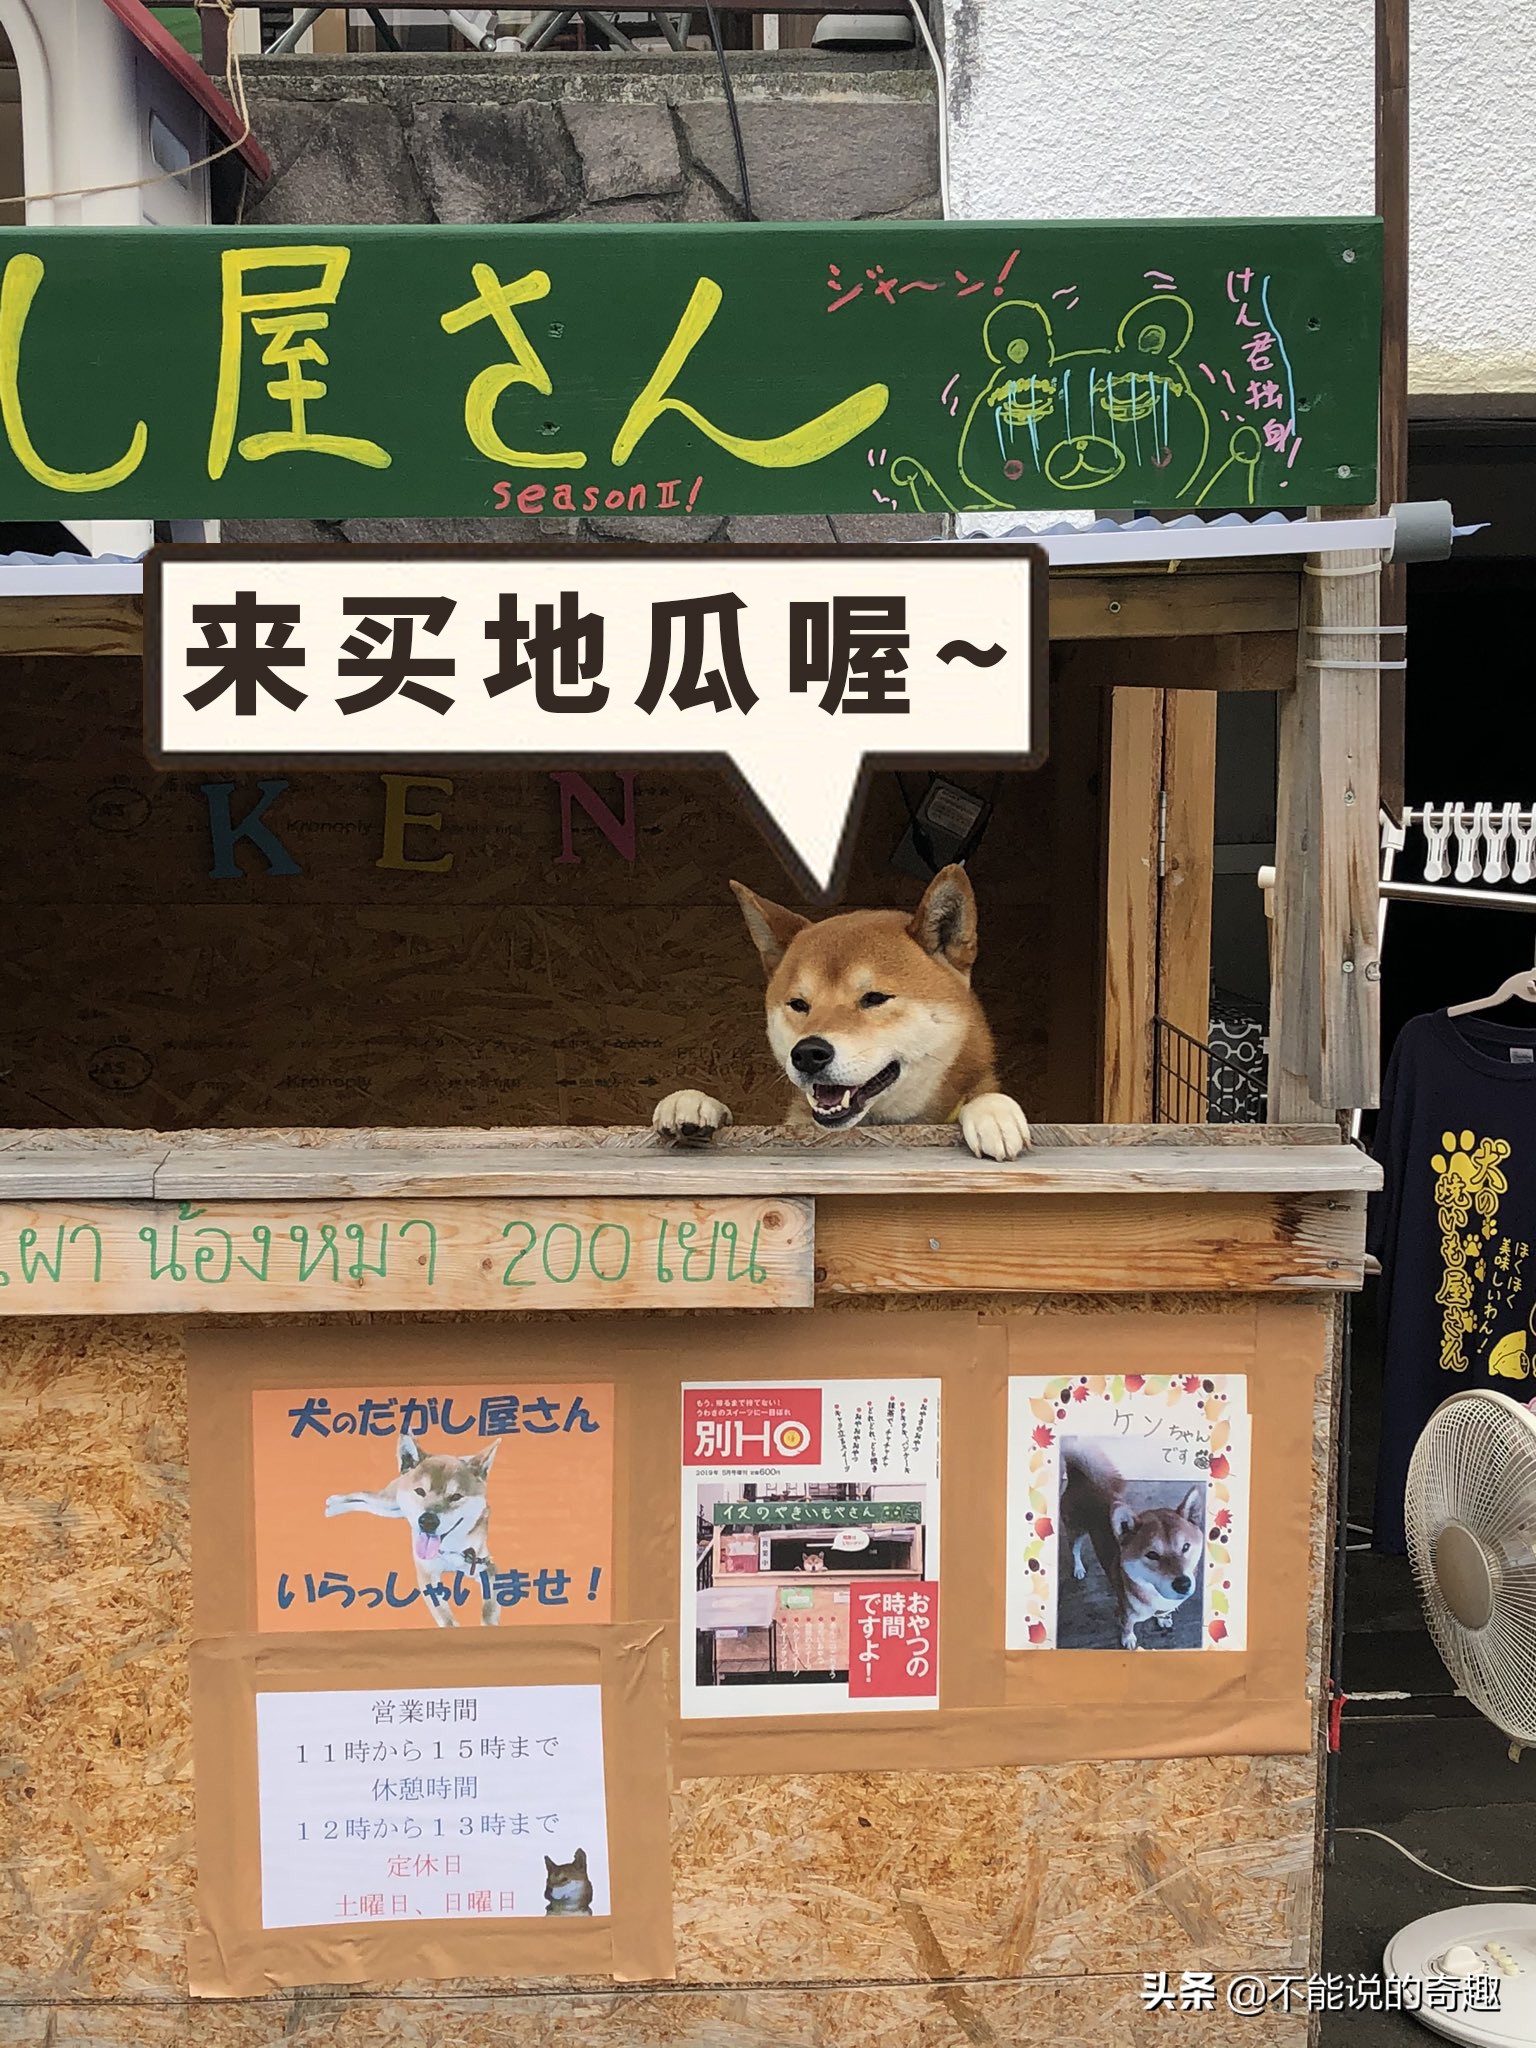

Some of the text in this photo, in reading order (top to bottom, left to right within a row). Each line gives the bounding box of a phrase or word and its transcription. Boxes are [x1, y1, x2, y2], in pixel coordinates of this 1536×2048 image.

[503, 1221, 630, 1286] 200
[1506, 1242, 1530, 1310] ほくほく
[289, 1395, 600, 1438] 犬のだがし屋さん
[1162, 1447, 1189, 1466] です
[278, 1567, 602, 1609] いらっしゃいませ!
[882, 1592, 905, 1639] 時間
[906, 1591, 930, 1678] おやつの
[858, 1593, 881, 1682] ですよ!
[372, 1699, 478, 1724] 営業時間
[372, 1776, 478, 1801] 休憩時間
[387, 1854, 462, 1878] 定休日
